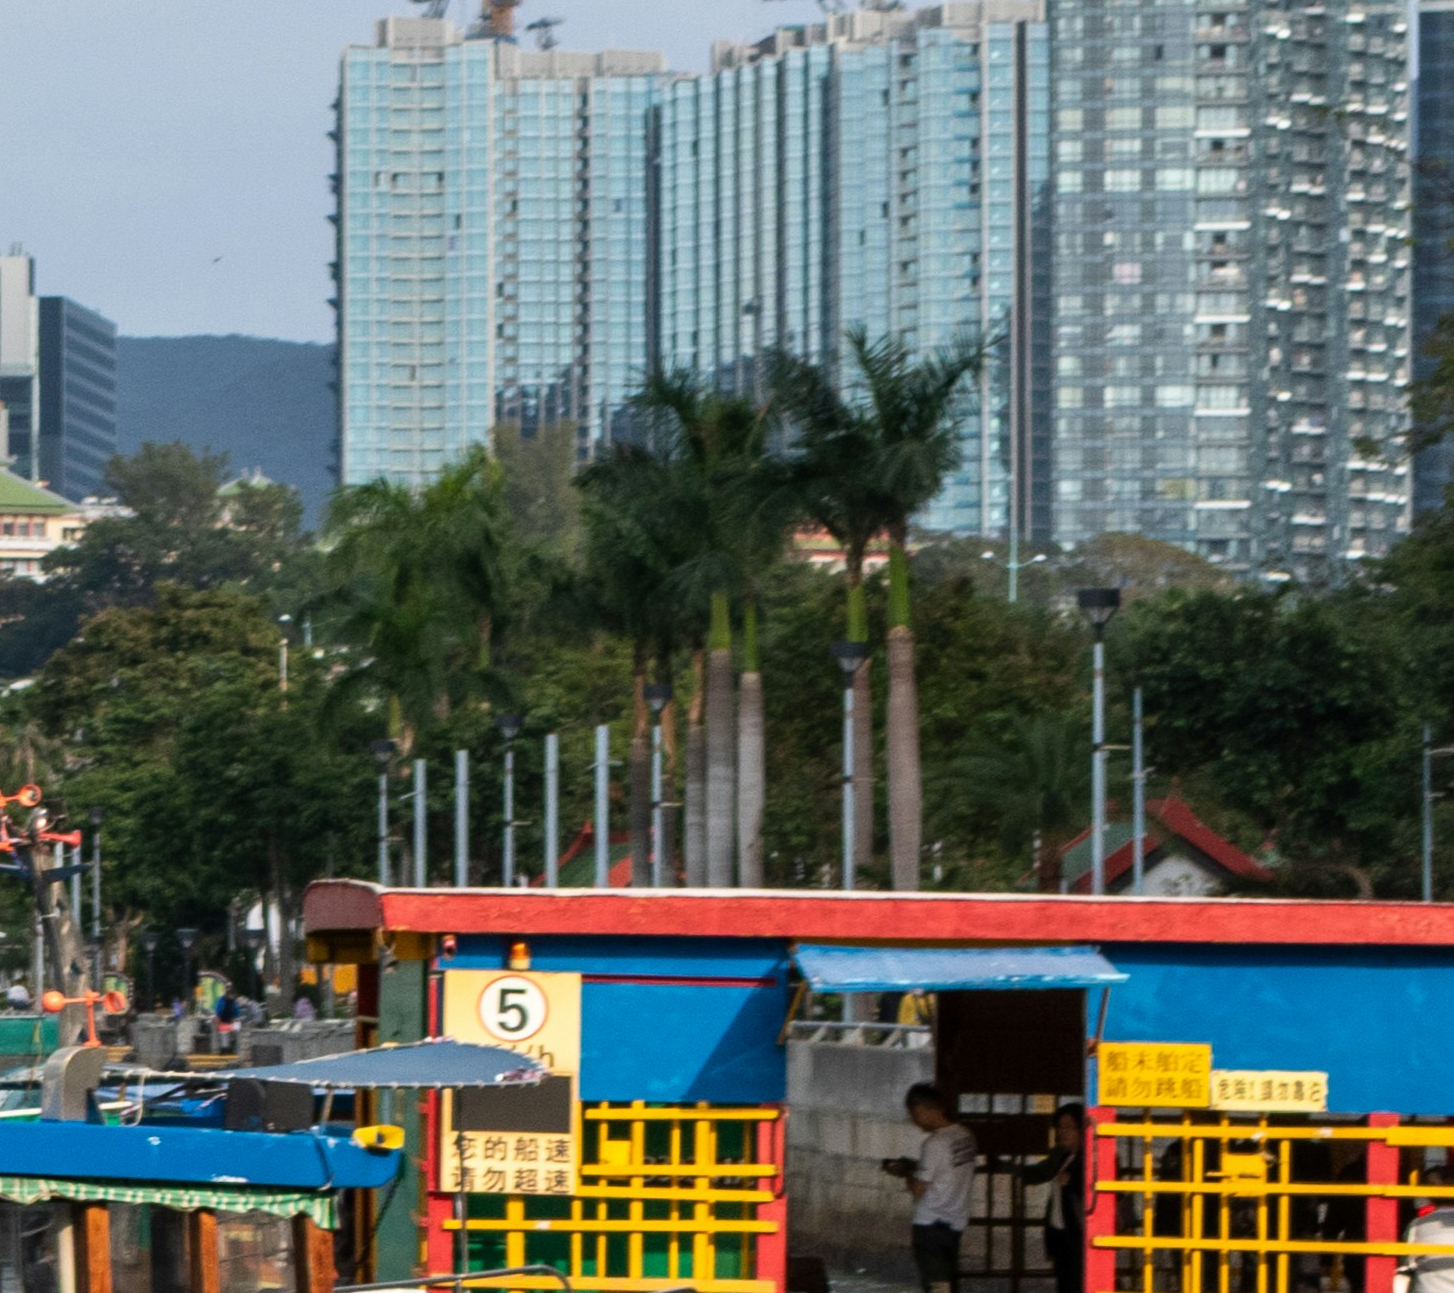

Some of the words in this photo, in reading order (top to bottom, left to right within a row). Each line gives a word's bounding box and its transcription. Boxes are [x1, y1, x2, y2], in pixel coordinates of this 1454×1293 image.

[498, 988, 528, 1032] 5
[453, 1136, 572, 1164] 您的船速
[451, 1167, 571, 1195] 请勿超速
